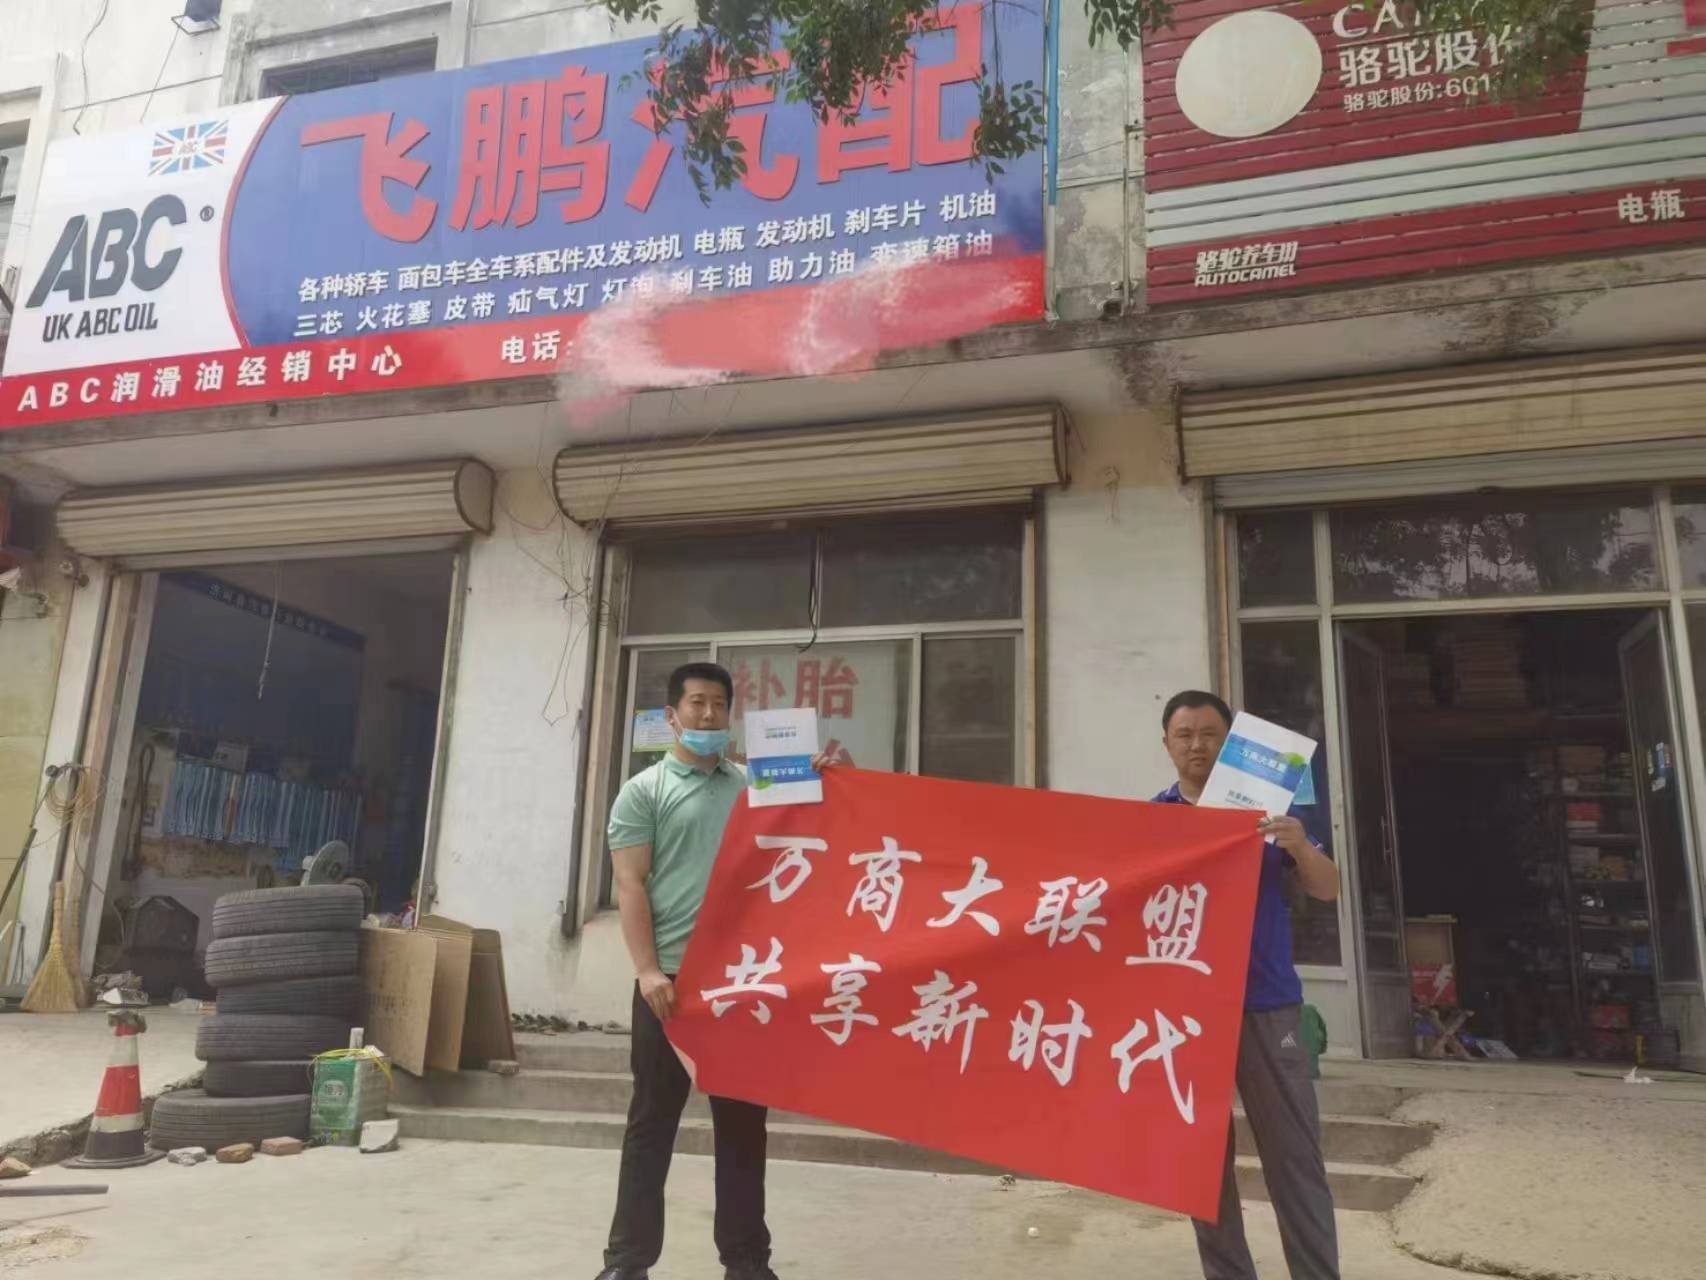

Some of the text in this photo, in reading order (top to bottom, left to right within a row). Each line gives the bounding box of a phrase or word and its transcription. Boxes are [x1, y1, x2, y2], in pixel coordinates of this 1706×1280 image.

[300, 2, 984, 243] 飞鹏汽配
[297, 189, 997, 302] 各种轿车 面包车全车系配件及发动机 电瓶 发动机 刹车片 机油
[1617, 188, 1686, 223] 电瓶
[25, 194, 187, 309] ABC
[294, 310, 344, 337] 三芯
[356, 301, 433, 331] 火花塞
[444, 291, 496, 322] 皮带
[507, 282, 590, 315] 疝气灯
[671, 262, 753, 295] 刹车油
[768, 248, 856, 283] 助力油
[1194, 263, 1297, 287] AUTOCAMEL
[42, 302, 158, 343] UK ABC OIL
[17, 345, 402, 411] ABC润滑油经销中心
[731, 657, 858, 720] 补胎
[745, 835, 1212, 975] 万商大联盟
[700, 937, 1201, 1124] 共享新时代
